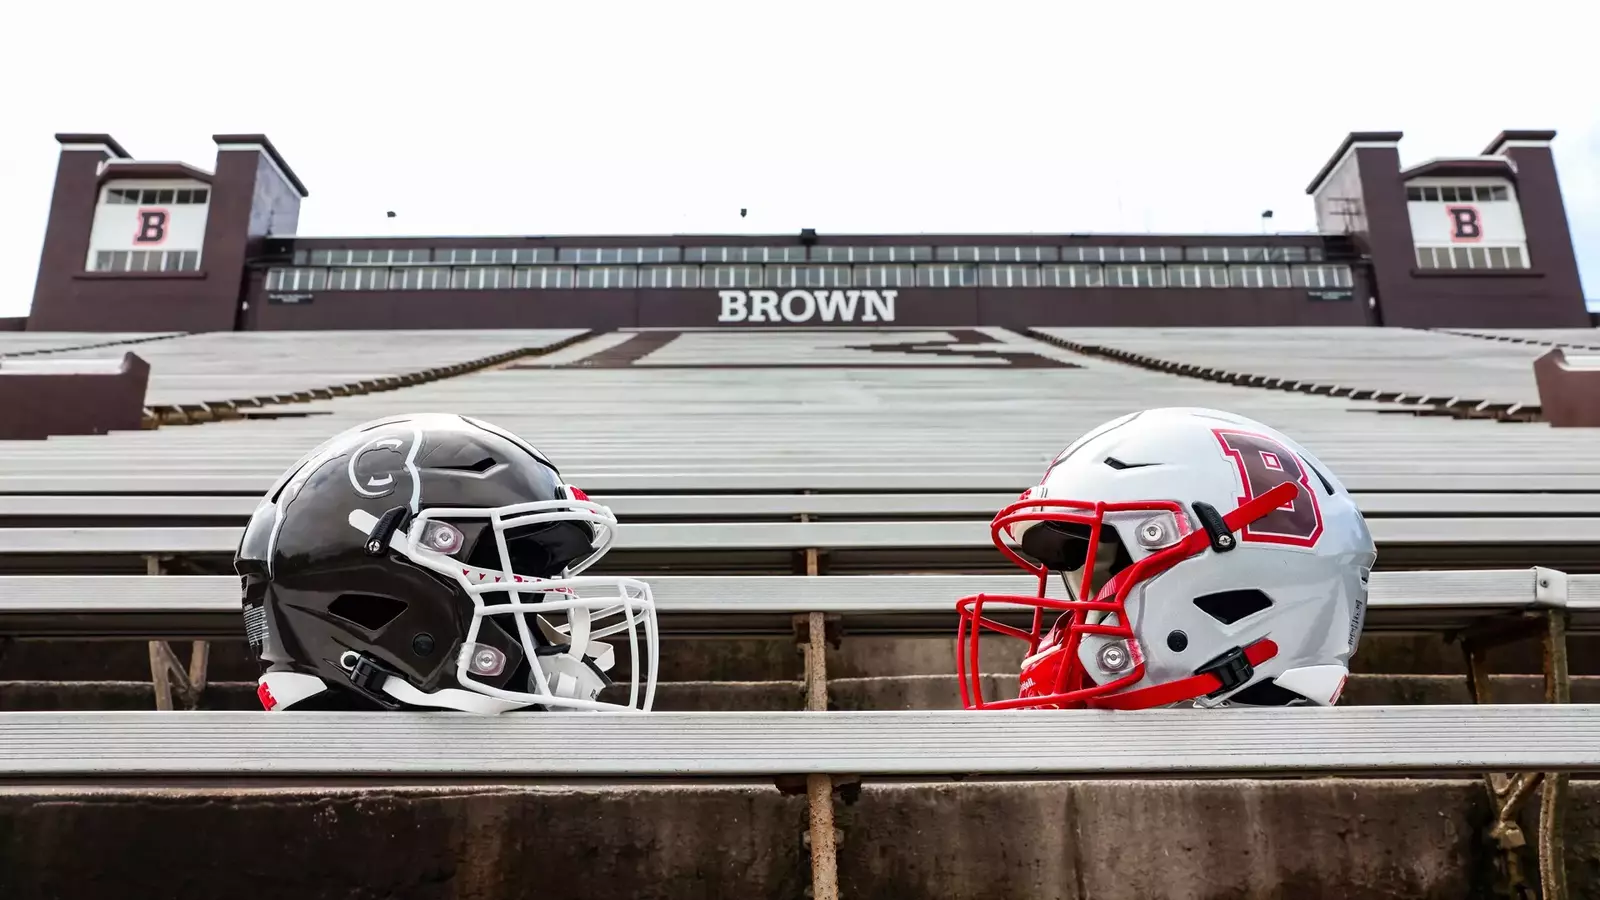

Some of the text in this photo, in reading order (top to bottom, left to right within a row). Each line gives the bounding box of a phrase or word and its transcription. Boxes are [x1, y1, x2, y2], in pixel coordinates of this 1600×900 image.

[134, 208, 169, 244] B
[1446, 205, 1482, 242] B
[718, 290, 898, 322] BROWN
[1210, 428, 1324, 548] B
